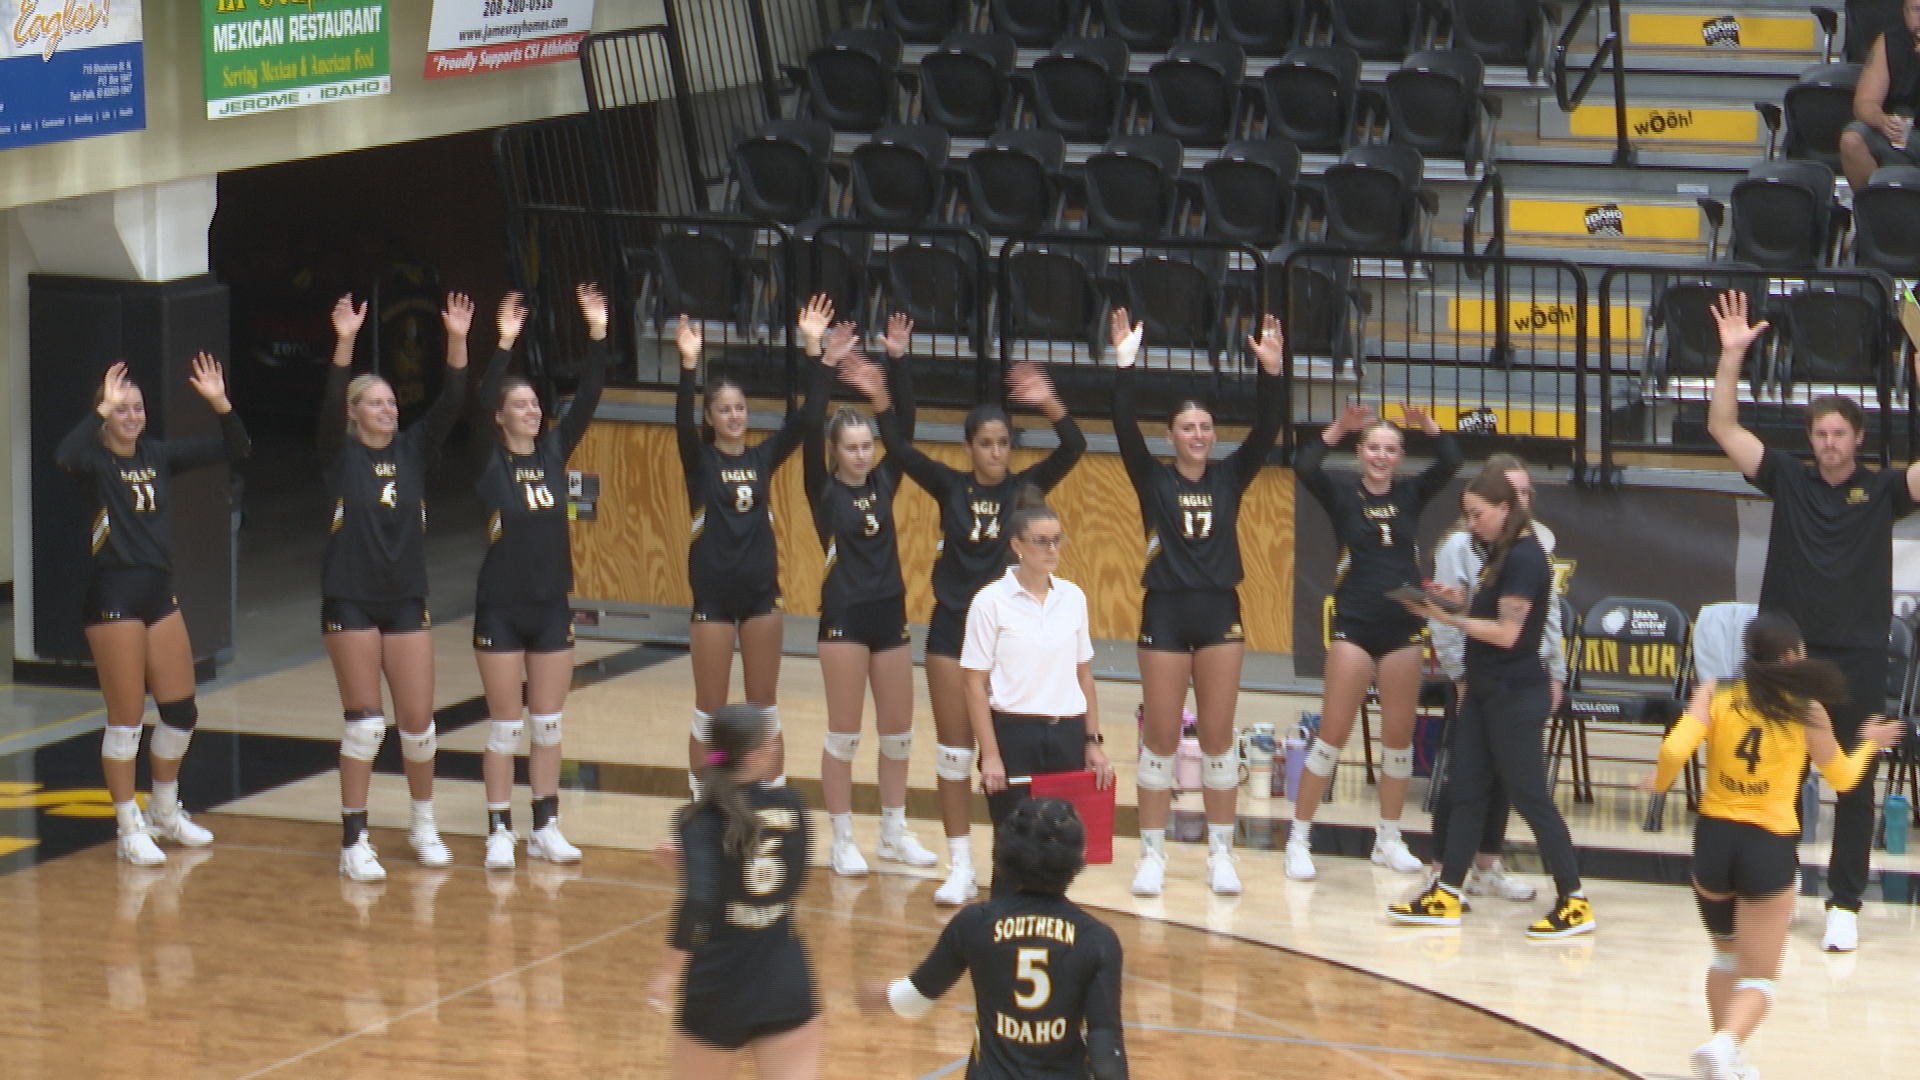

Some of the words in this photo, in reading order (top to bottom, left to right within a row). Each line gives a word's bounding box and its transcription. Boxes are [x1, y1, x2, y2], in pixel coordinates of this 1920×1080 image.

[213, 16, 285, 53] MEXICAN
[289, 5, 383, 43] RESTAURANT
[459, 17, 569, 42] www.jamesrayhomes.com
[222, 64, 258, 89] Serving
[261, 59, 298, 82] Mexican
[300, 55, 308, 76] &
[311, 53, 352, 76] American
[354, 46, 375, 70] Food
[479, 45, 523, 69] Supports
[524, 43, 541, 60] CSI
[219, 91, 300, 115] JEROME
[320, 79, 381, 99] IDAHO
[131, 483, 157, 512] 11
[523, 481, 556, 511] 10
[735, 484, 755, 514] 8
[864, 513, 880, 537] 3
[968, 514, 1001, 543] 14
[1182, 509, 1213, 539] 17
[1377, 522, 1395, 548] 1
[1630, 619, 1667, 631] Central
[1632, 609, 1660, 620] Idaho
[1735, 726, 1763, 775] 4
[740, 835, 790, 899] 6
[993, 916, 1076, 946] SOUTHERN
[1013, 947, 1051, 1010] 5
[996, 1011, 1068, 1043] IDAHO
